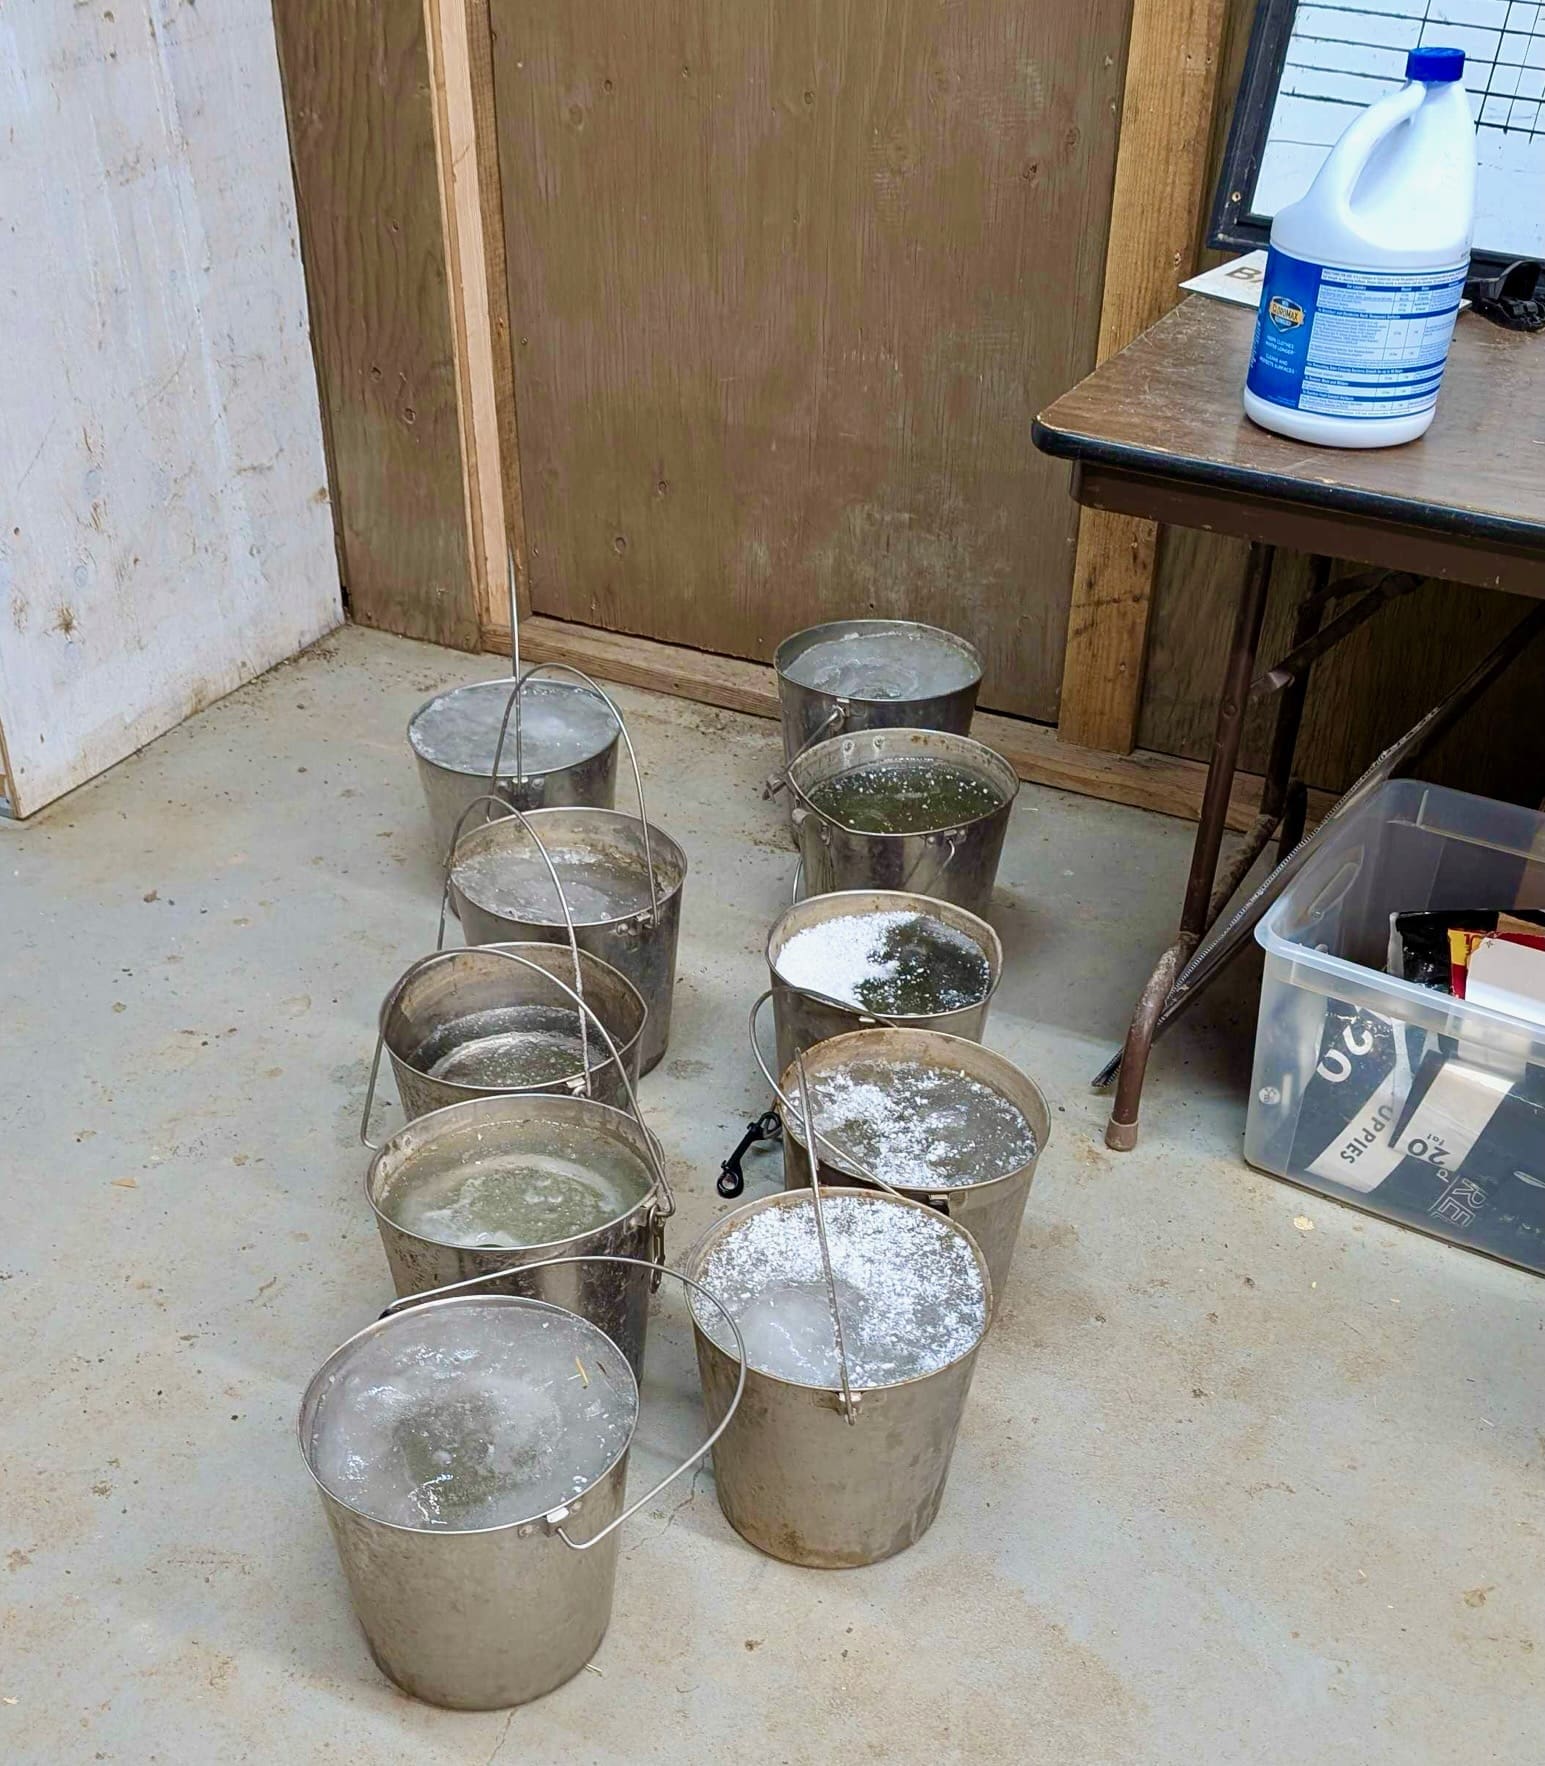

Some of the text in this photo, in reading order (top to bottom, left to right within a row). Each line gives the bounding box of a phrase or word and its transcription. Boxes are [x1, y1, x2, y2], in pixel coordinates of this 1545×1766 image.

[1224, 266, 1264, 283] B
[1427, 1133, 1445, 1146] fat
[1407, 1138, 1451, 1165] 20
